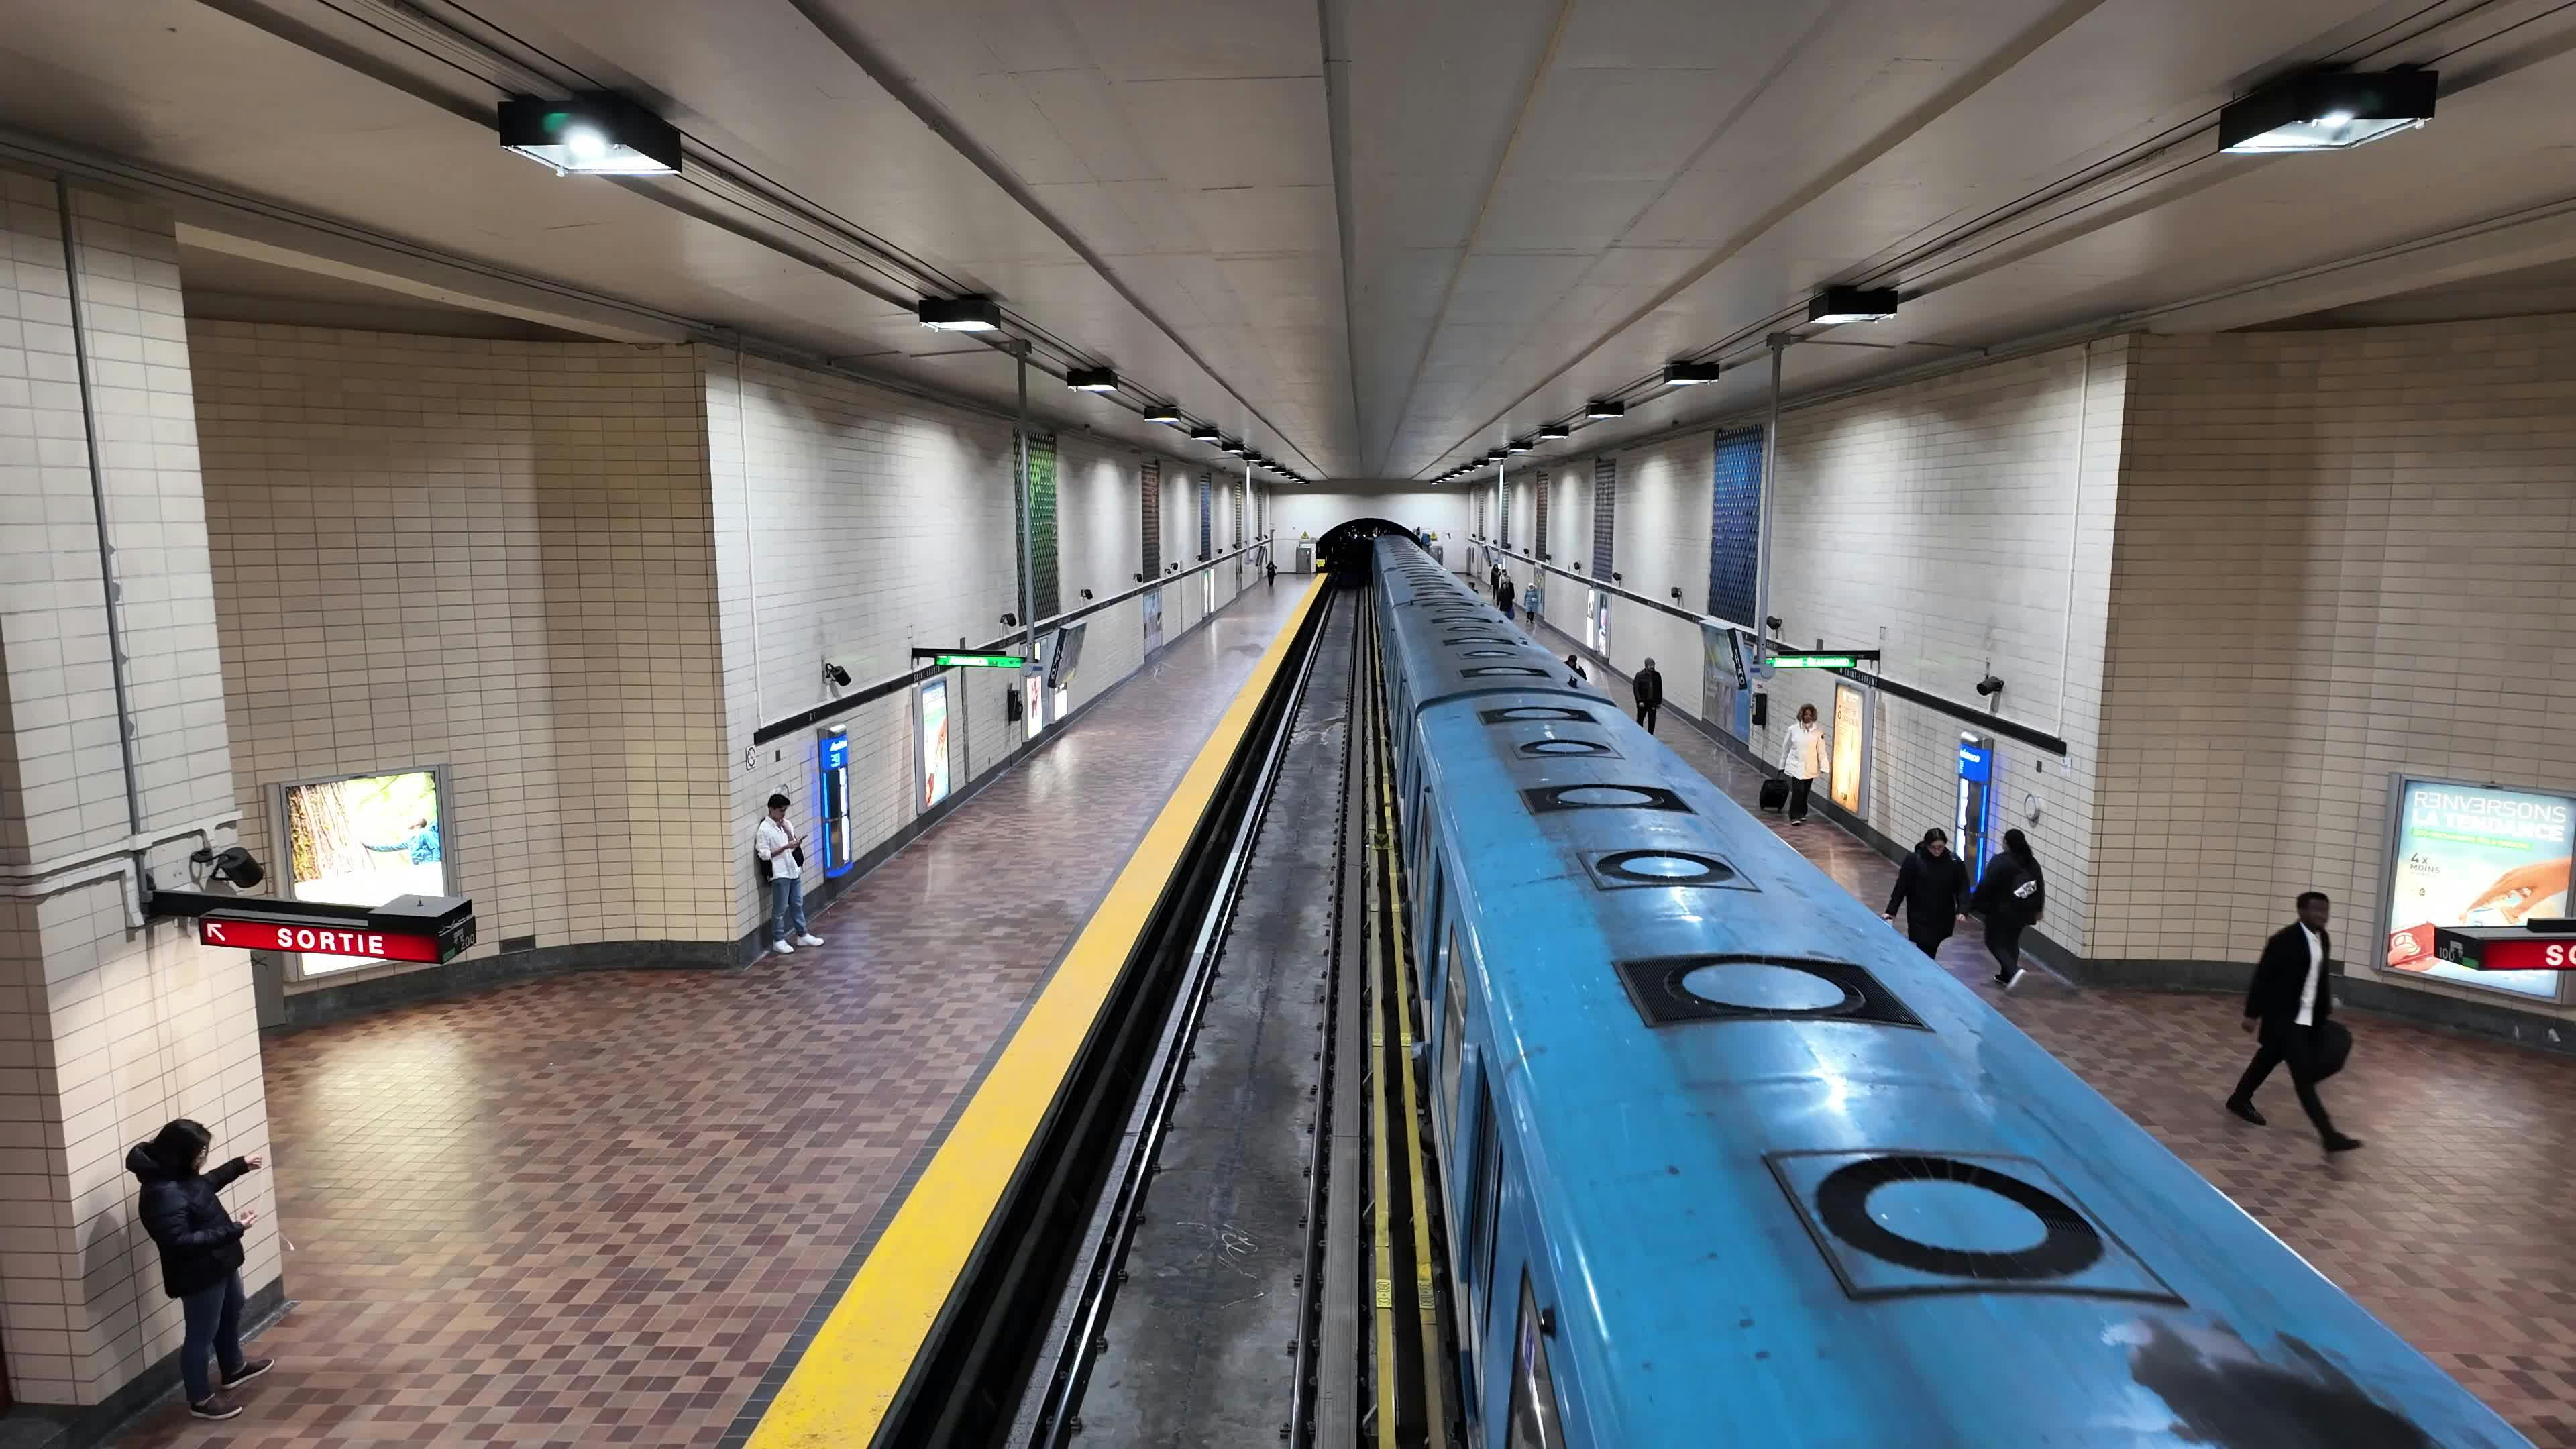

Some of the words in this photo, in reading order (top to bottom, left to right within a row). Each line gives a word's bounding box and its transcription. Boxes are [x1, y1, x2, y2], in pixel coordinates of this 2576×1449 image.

[1845, 668, 1878, 686] SAINT-LAURENT
[2412, 808, 2438, 826] LA
[2446, 812, 2565, 842] TENDANCE
[2411, 853, 2419, 863] 4
[2410, 864, 2441, 873] MOINS
[277, 928, 384, 955] SORTIE
[461, 933, 475, 950] 200
[2439, 947, 2455, 961] 100
